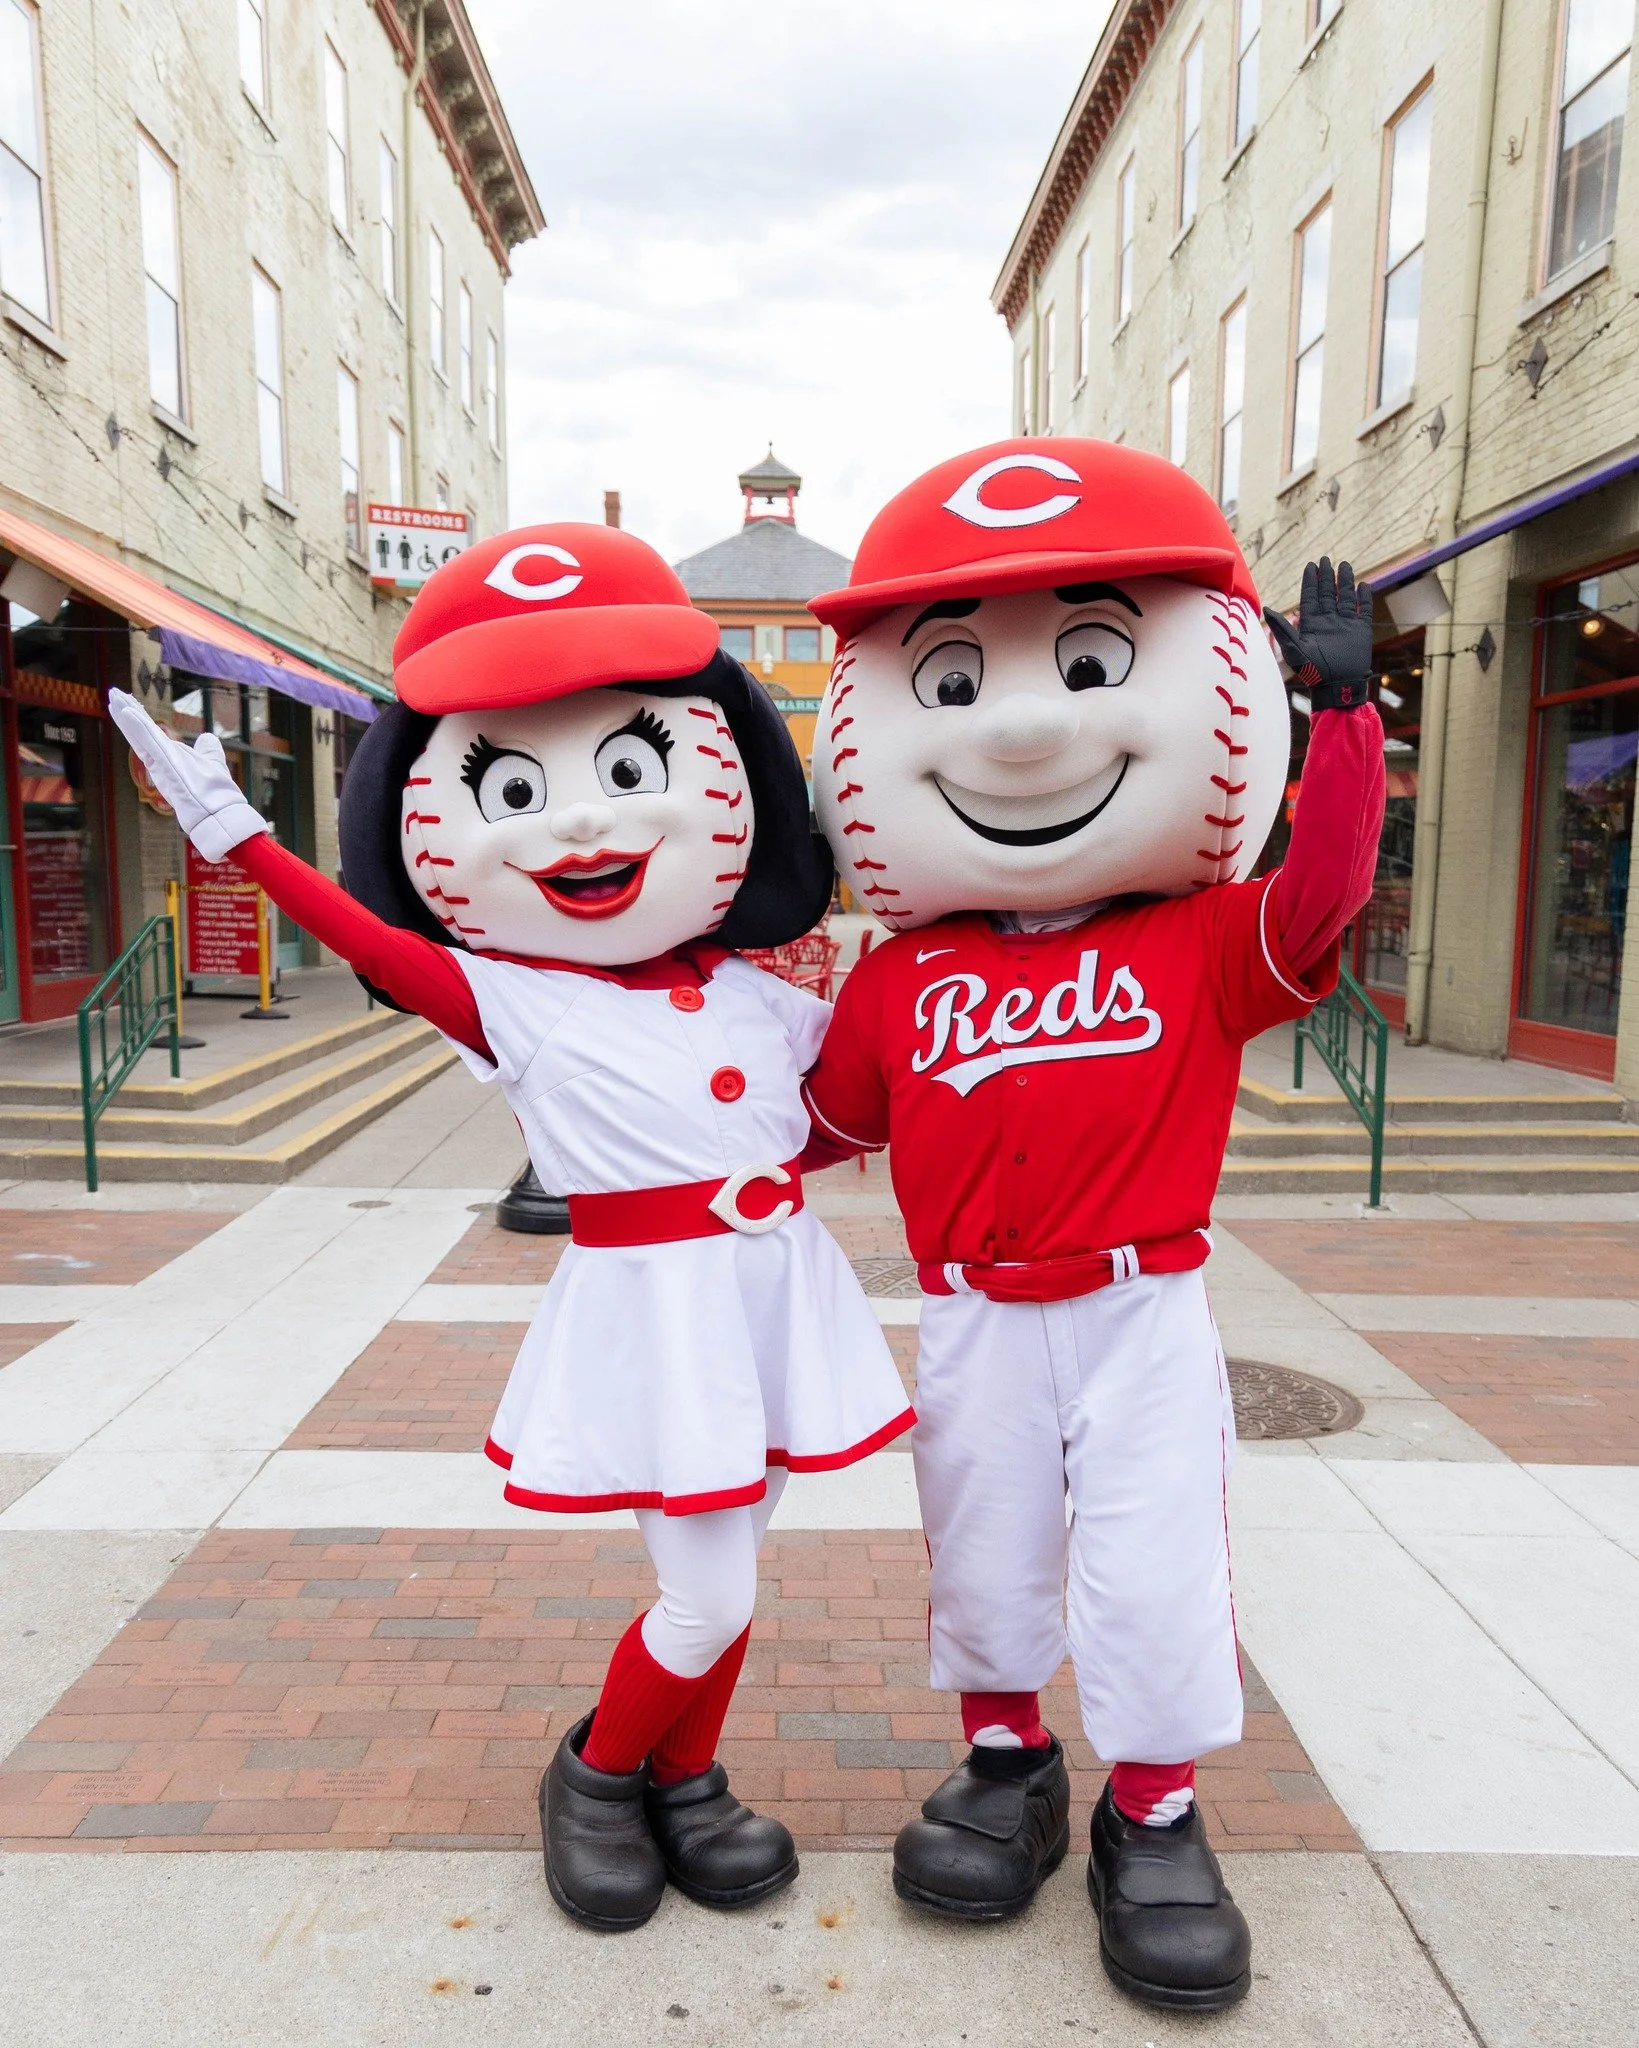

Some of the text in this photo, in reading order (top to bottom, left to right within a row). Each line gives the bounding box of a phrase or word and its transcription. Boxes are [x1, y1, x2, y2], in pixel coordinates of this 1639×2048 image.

[371, 508, 464, 529] RESTROOMS
[942, 453, 1083, 529] C
[484, 542, 583, 601] C
[911, 949, 1163, 1098] Reds
[707, 1163, 794, 1234] C
